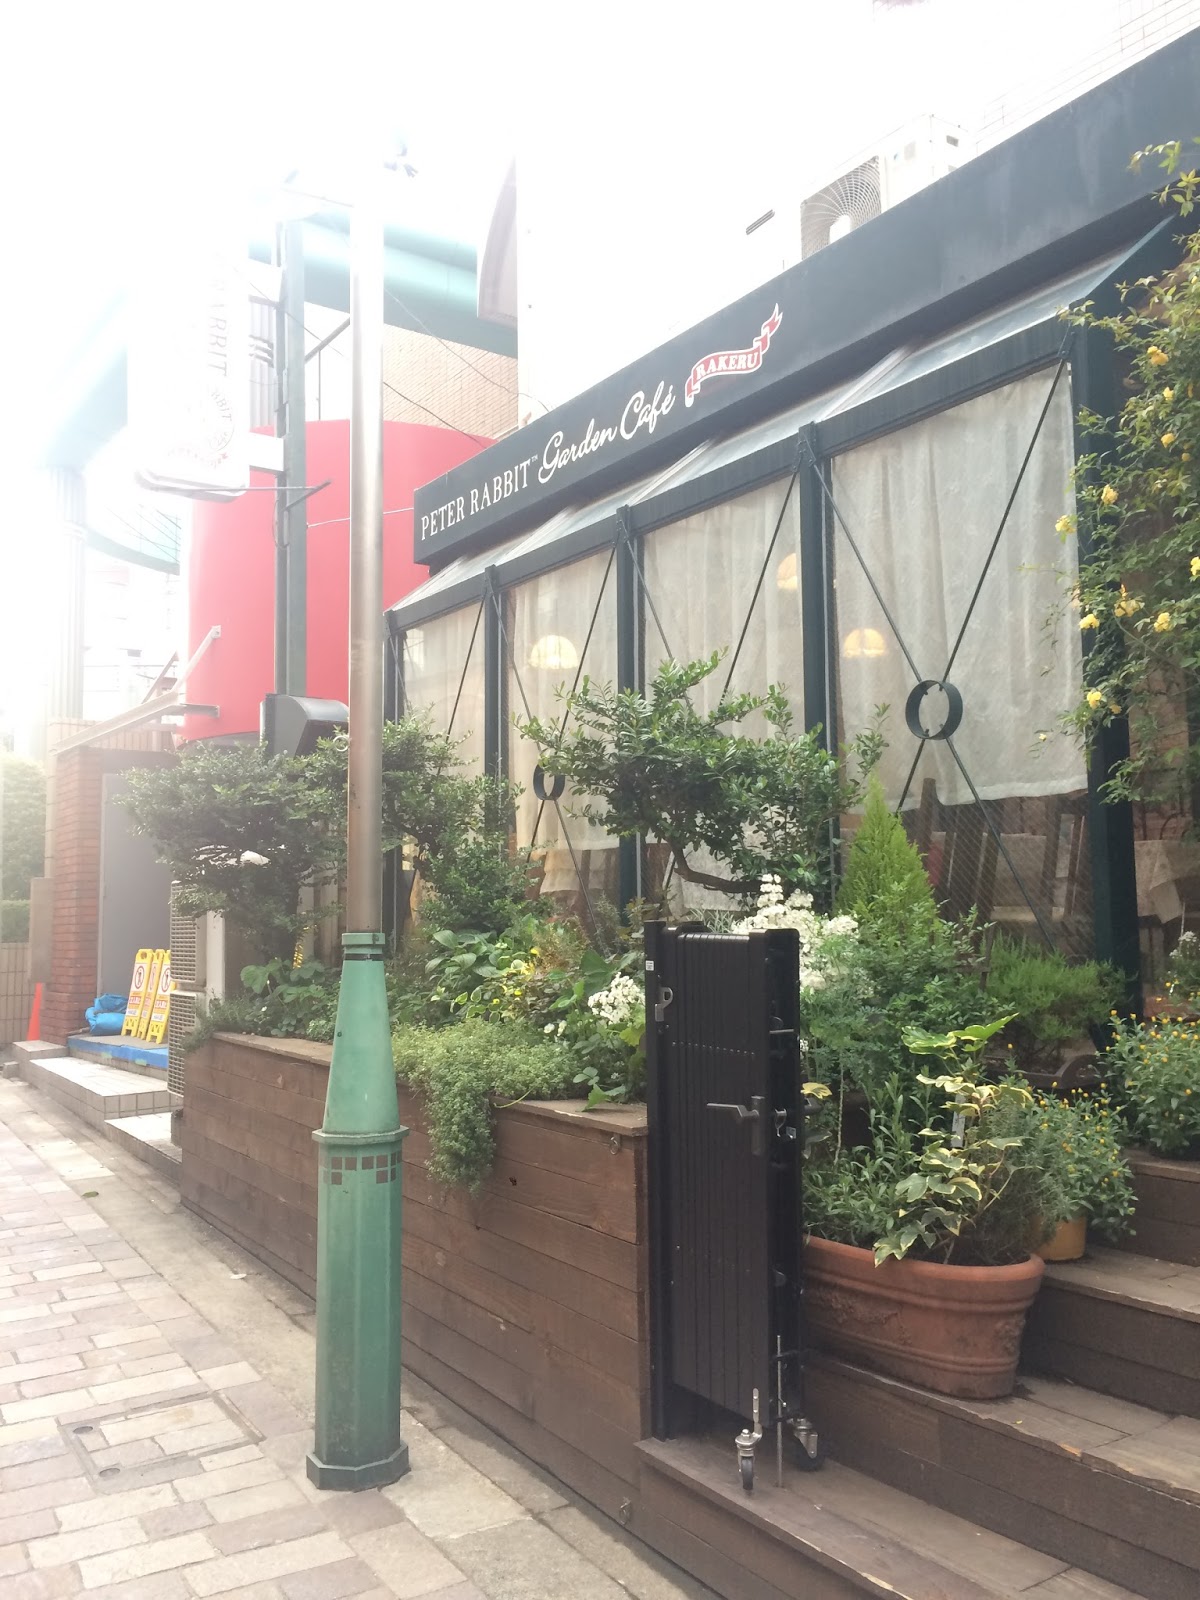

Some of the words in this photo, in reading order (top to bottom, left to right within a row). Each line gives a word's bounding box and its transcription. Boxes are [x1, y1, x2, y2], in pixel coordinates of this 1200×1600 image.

[696, 352, 759, 380] RAKERU
[421, 496, 465, 541] PETER
[470, 458, 531, 515] RABBIT
[538, 418, 618, 484] Garden
[620, 380, 676, 440] Café
